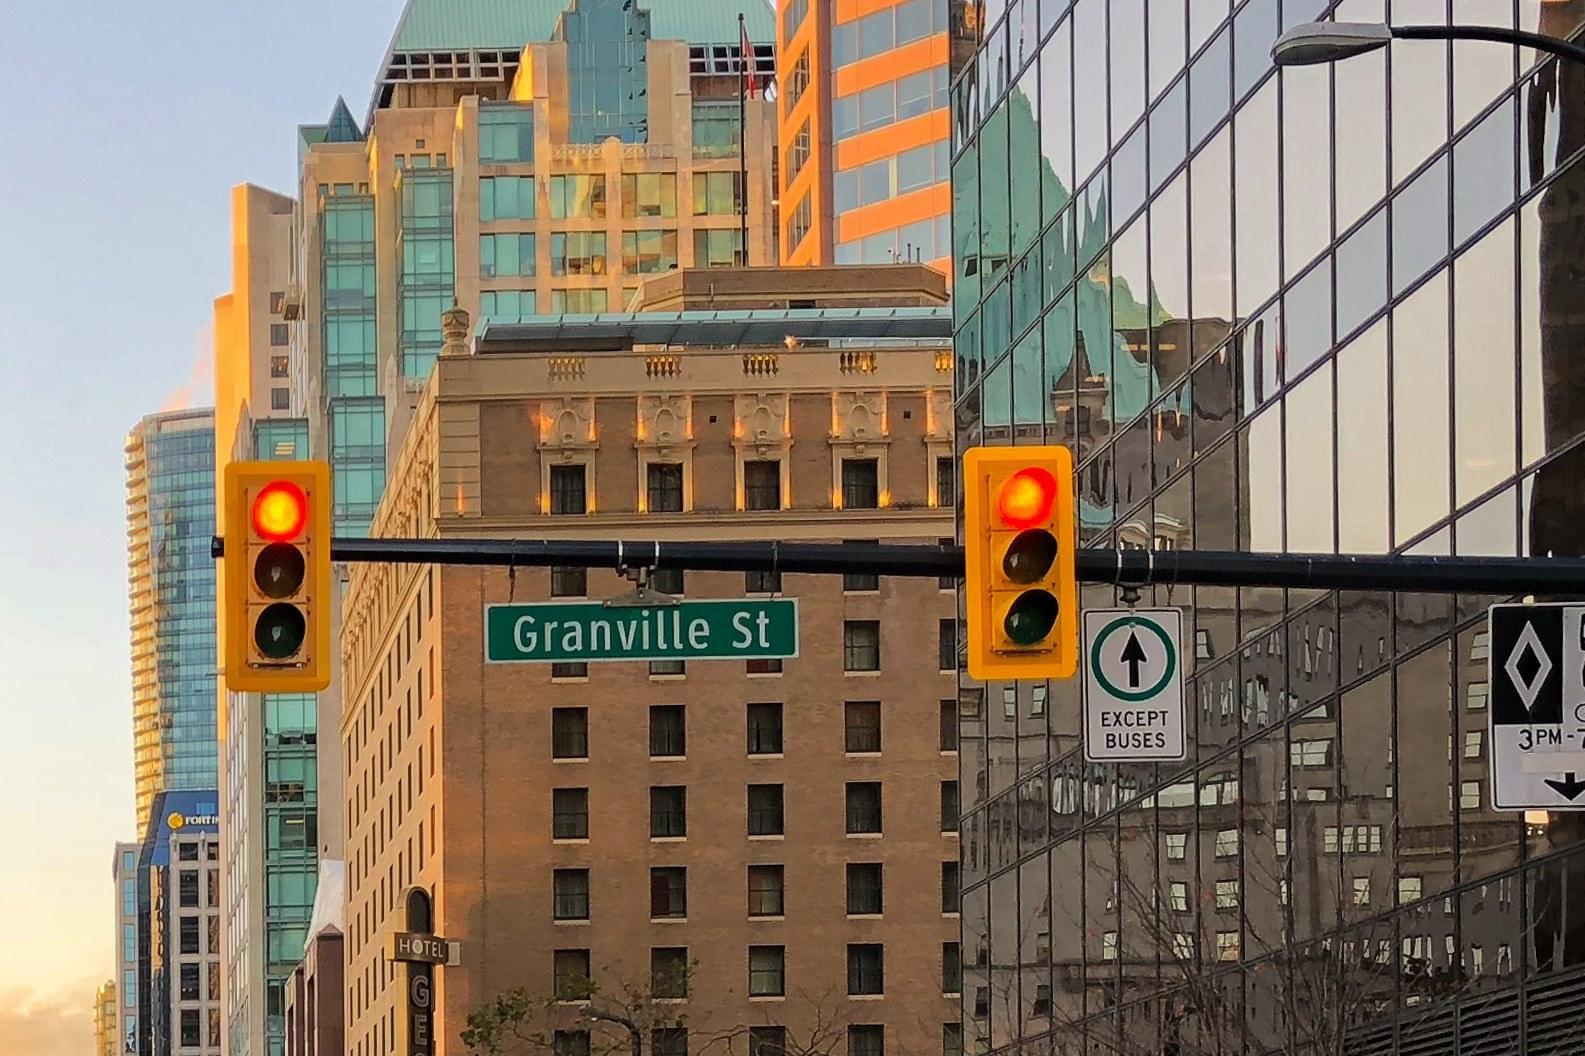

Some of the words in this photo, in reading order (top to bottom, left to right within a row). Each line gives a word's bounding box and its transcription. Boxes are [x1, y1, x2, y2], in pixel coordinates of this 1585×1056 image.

[513, 609, 710, 653] Granville
[731, 610, 770, 649] St
[1101, 710, 1168, 727] EXCEPT
[1106, 732, 1165, 748] BUSES
[399, 938, 443, 958] HOTEL
